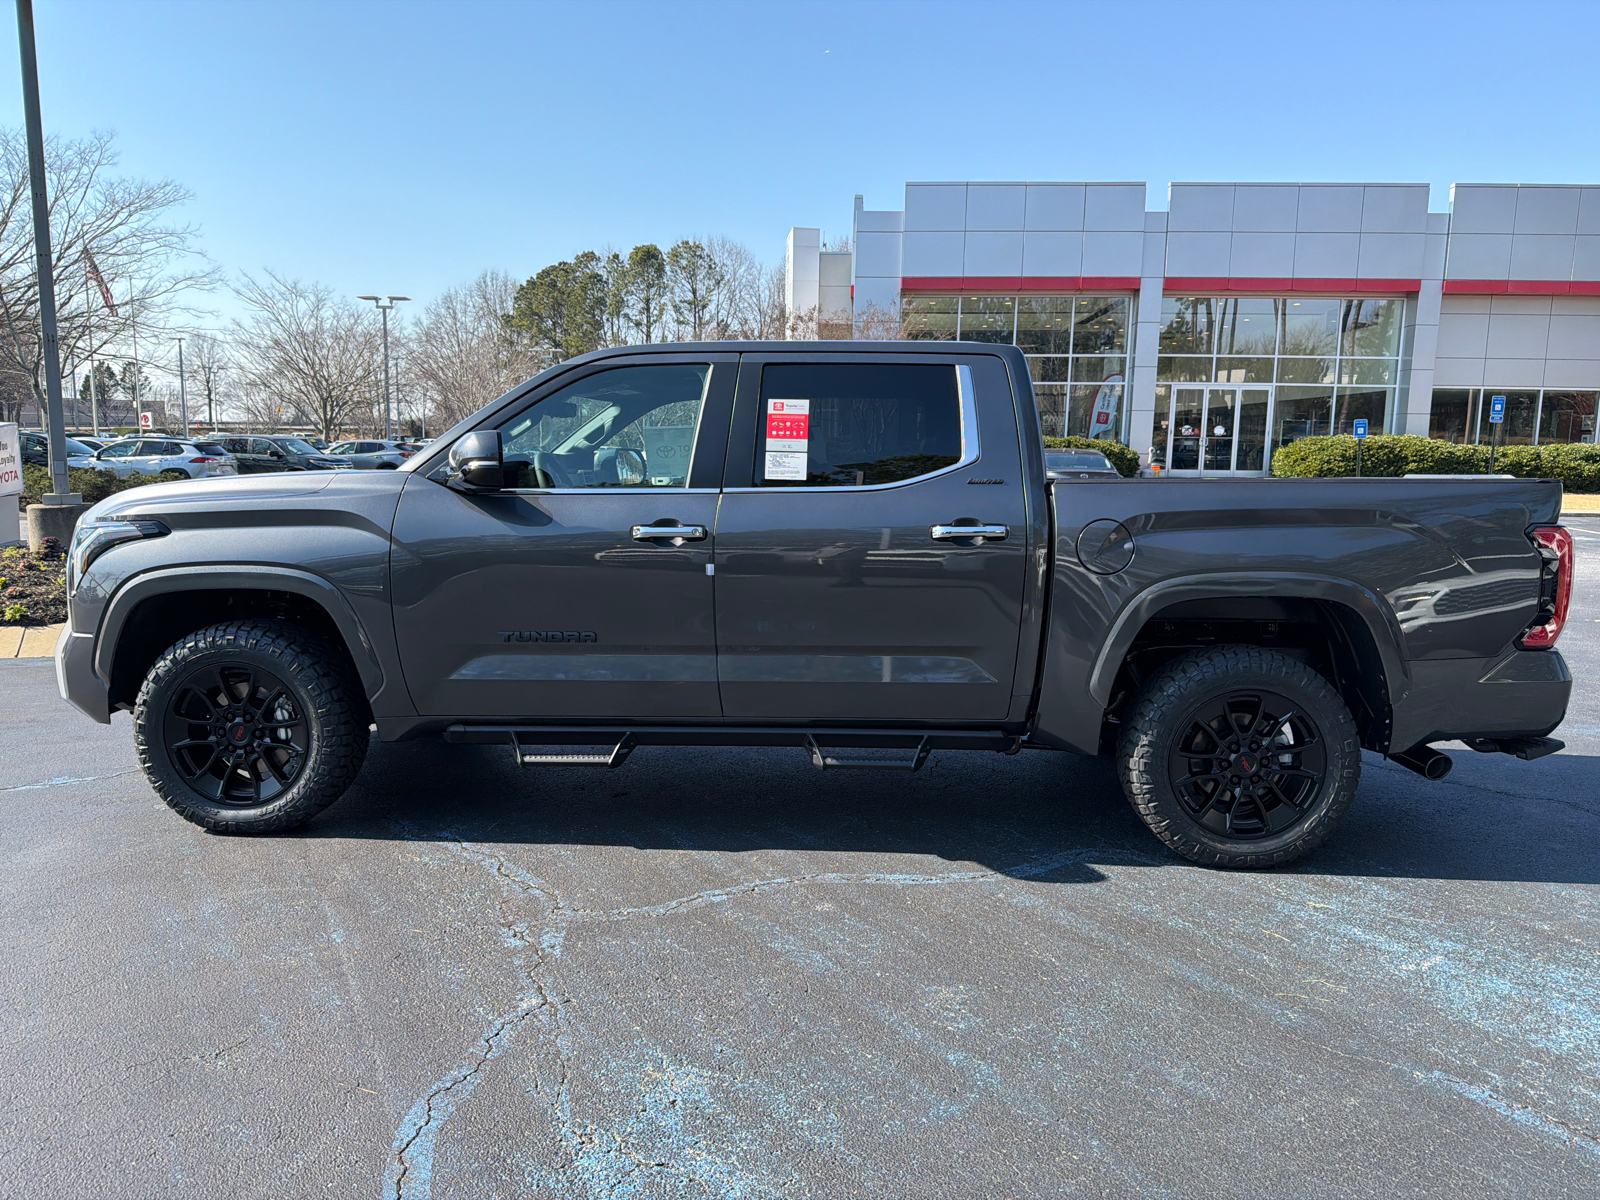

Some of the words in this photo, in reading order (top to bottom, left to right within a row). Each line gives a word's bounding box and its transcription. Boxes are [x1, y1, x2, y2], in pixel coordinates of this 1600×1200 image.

[497, 631, 597, 643] TUNDRA
[235, 725, 244, 741] TRD
[1241, 756, 1252, 772] TRD
